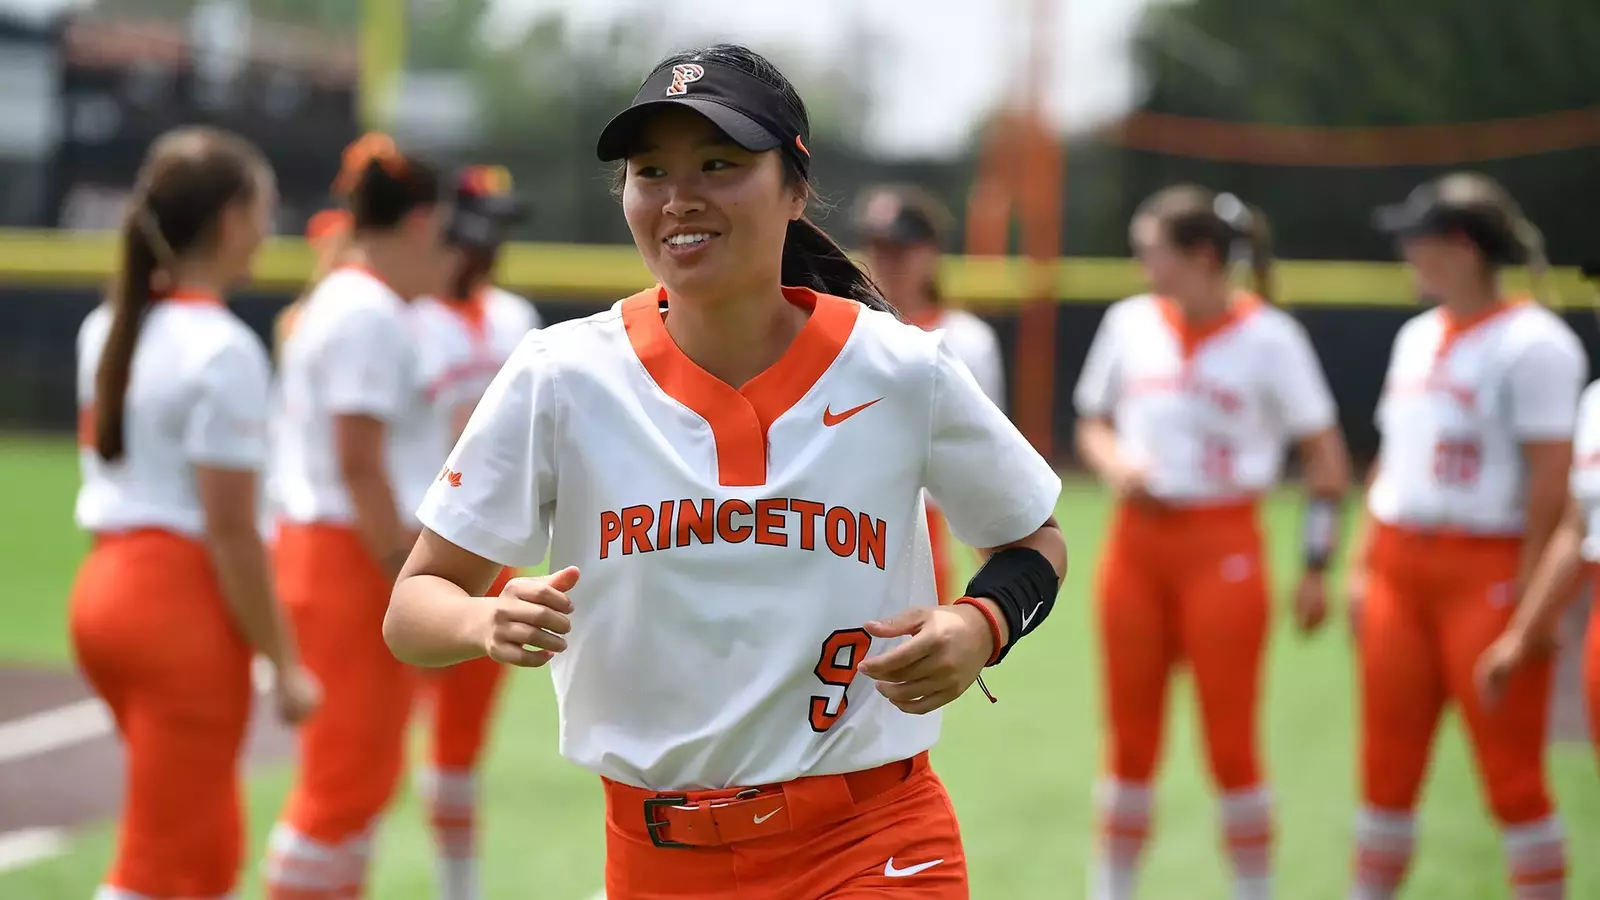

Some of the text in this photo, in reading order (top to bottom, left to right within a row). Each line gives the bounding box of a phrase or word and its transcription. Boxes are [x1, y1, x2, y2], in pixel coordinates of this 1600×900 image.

[666, 64, 704, 96] P
[600, 498, 886, 570] PRINCETON
[809, 627, 872, 732] 9
